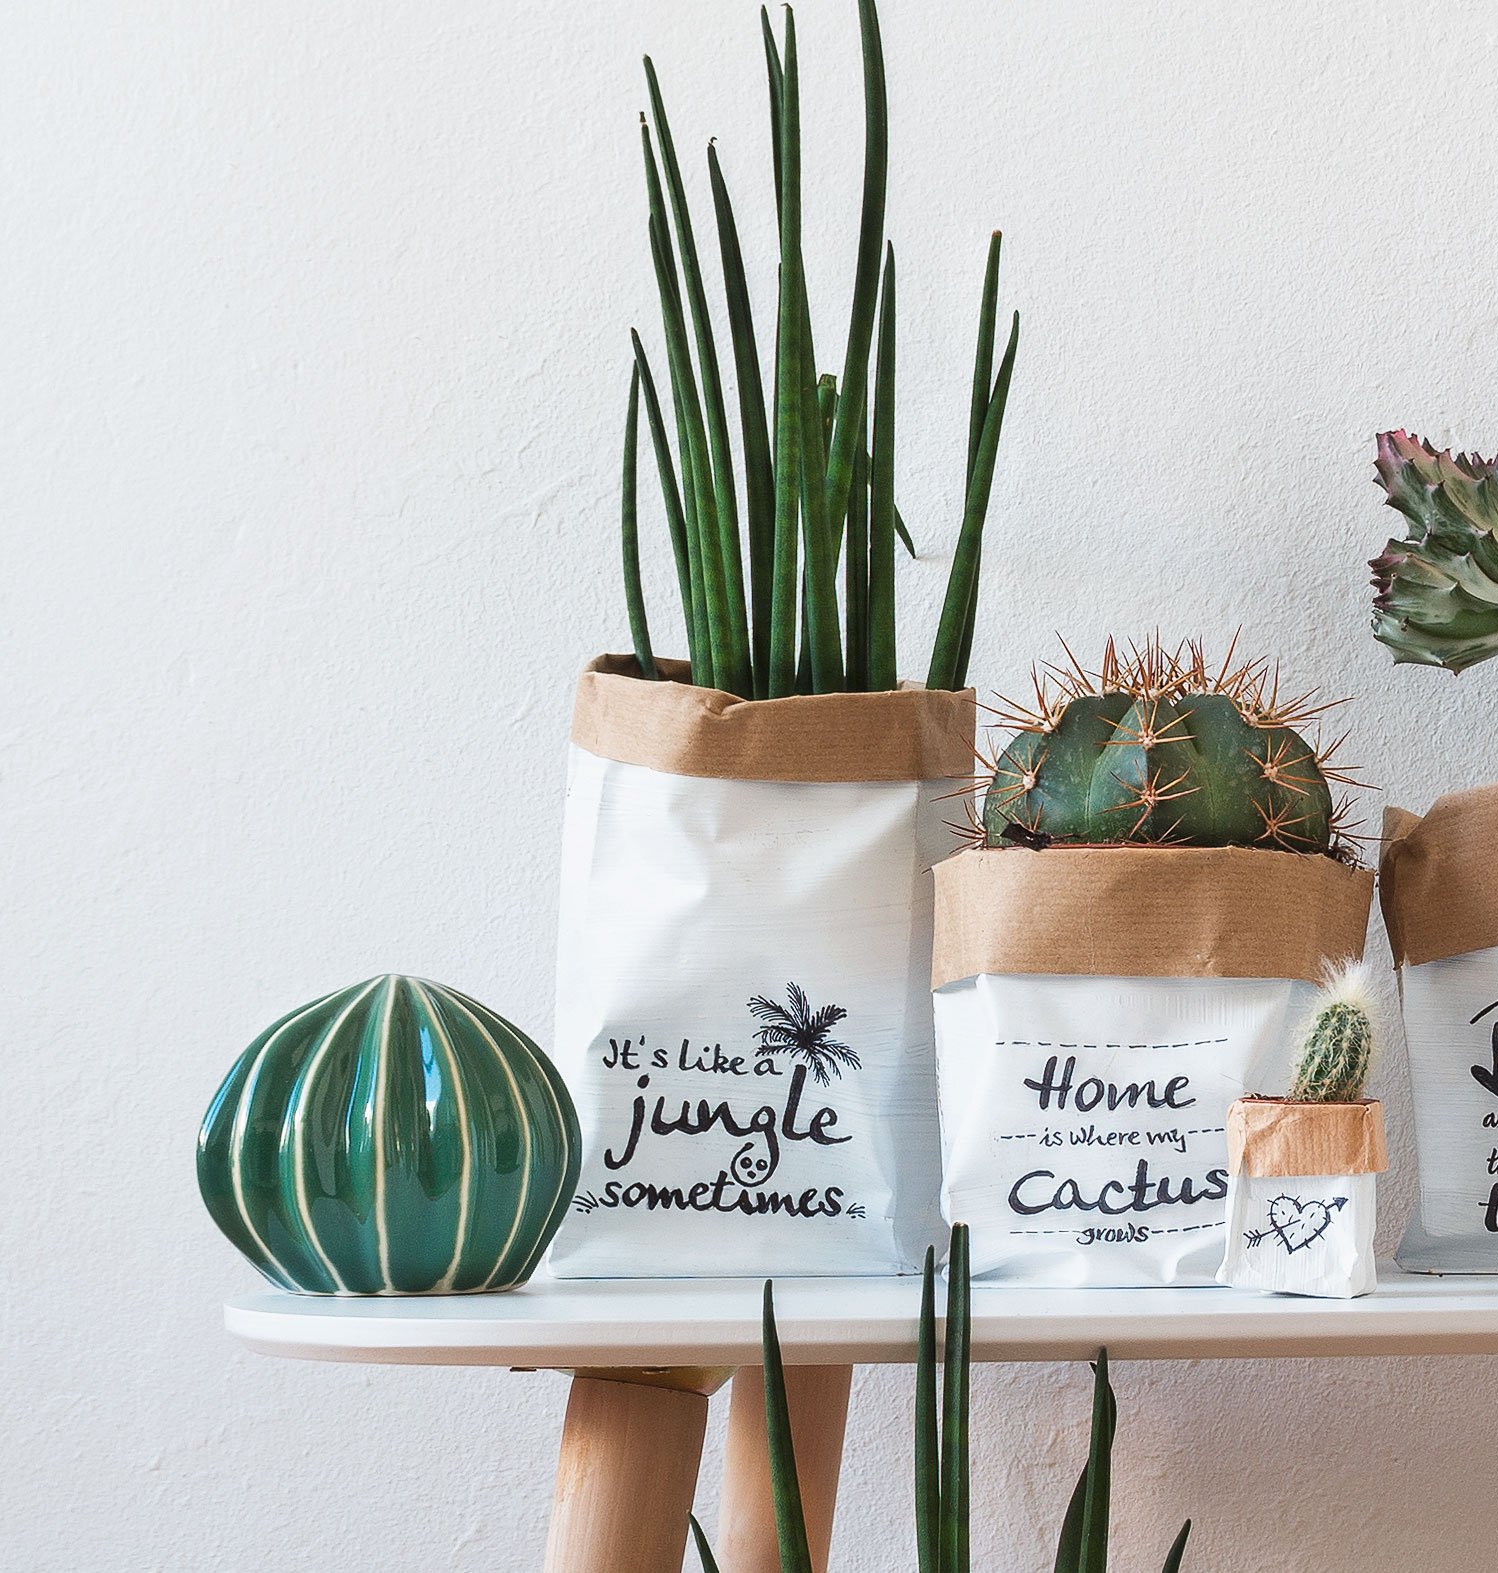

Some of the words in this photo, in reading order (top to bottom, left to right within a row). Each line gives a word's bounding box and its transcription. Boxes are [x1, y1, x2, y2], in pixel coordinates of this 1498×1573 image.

[603, 1035, 668, 1069] It's
[678, 1038, 748, 1073] like
[753, 1058, 783, 1076] a
[1023, 1055, 1197, 1112] Home
[604, 1064, 853, 1187] jungle
[1039, 1127, 1063, 1147] is
[1069, 1125, 1141, 1147] where
[1146, 1128, 1189, 1152] my
[598, 1170, 844, 1218] sometimes
[1076, 1222, 1150, 1245] grows
